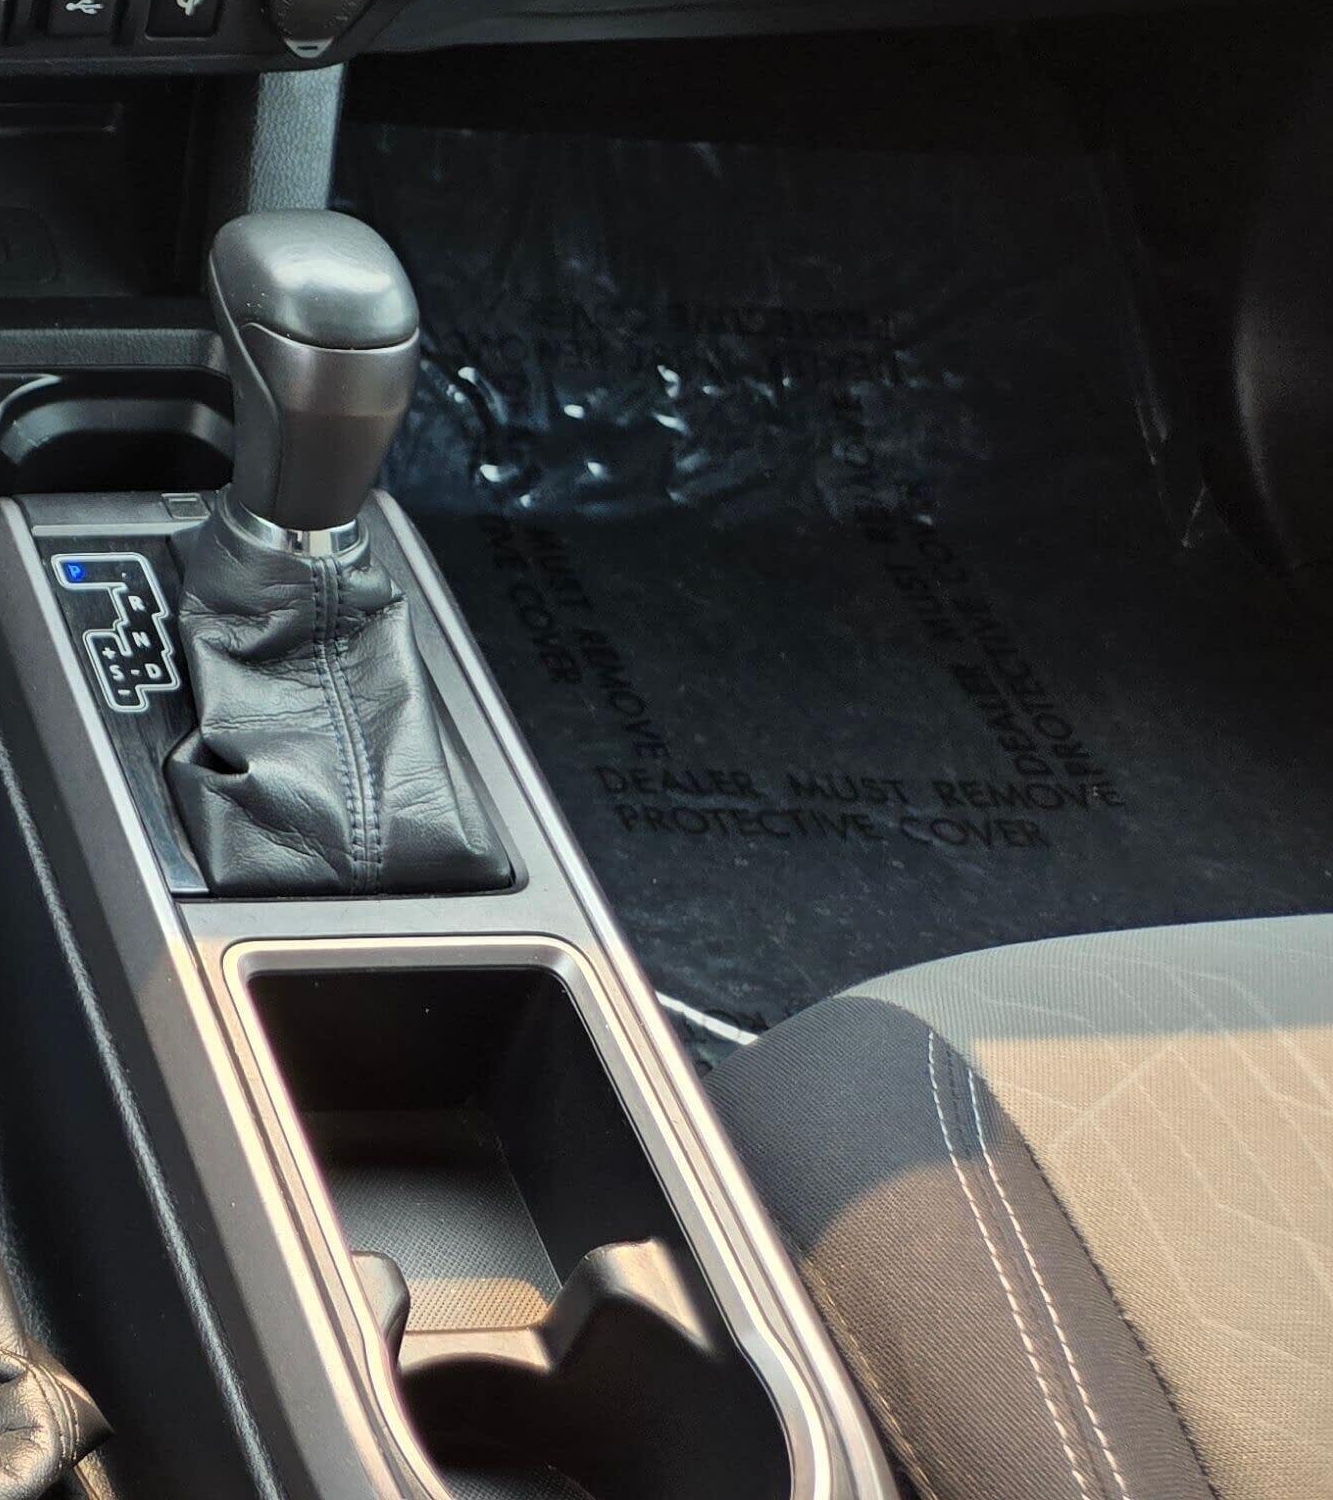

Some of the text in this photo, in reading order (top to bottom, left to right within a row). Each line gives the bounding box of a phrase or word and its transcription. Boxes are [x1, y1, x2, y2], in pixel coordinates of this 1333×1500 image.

[68, 563, 83, 579] P
[127, 595, 146, 611] R
[132, 631, 151, 648] N
[108, 664, 125, 680] S
[144, 663, 162, 679] D
[593, 764, 1126, 809] DEALER MUST REMOVE
[613, 802, 1055, 850] PROTECTIVE COVER
